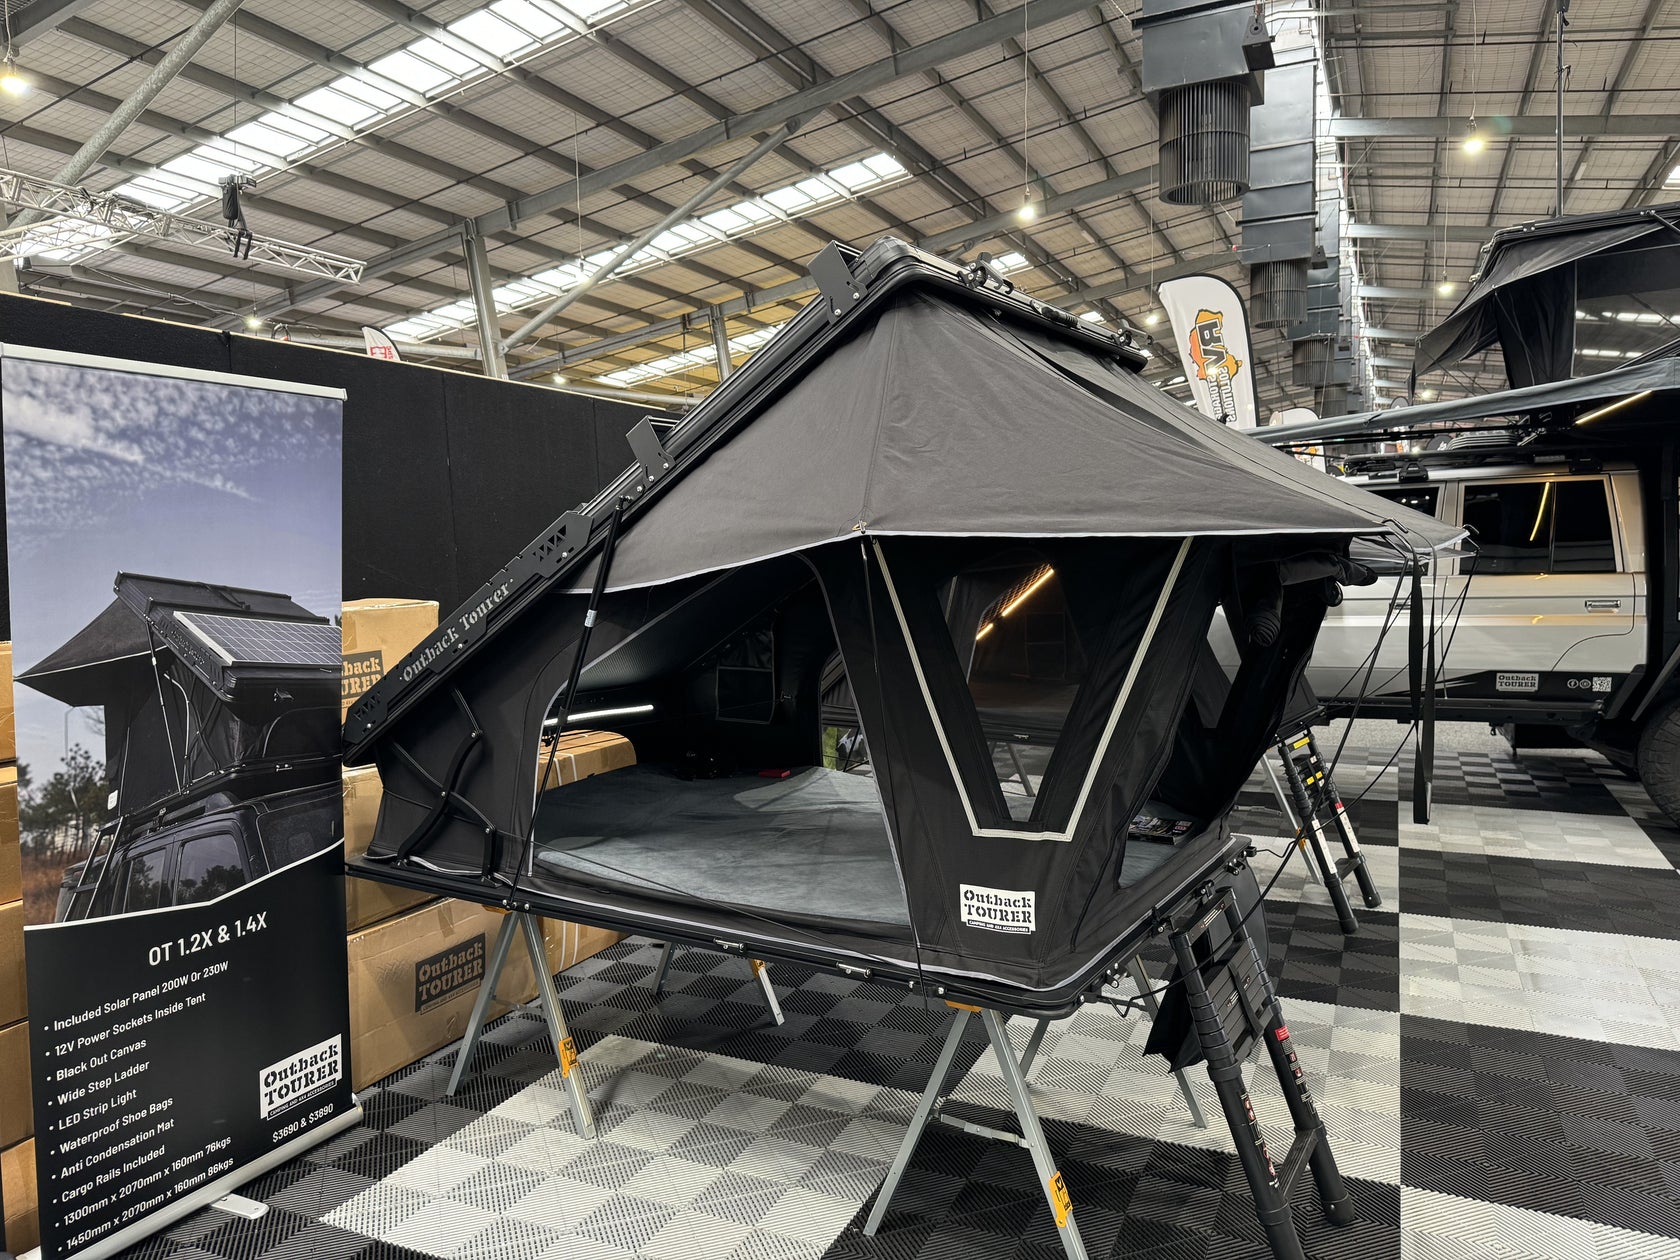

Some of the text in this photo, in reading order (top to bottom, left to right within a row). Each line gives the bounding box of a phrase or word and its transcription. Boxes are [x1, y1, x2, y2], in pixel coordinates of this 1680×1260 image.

[403, 583, 509, 682] Outback Tourer
[342, 657, 381, 677] back
[963, 889, 1032, 909] Outback
[963, 903, 1032, 924] TOURER
[149, 911, 268, 966] OT 1.2X & 1.4X
[418, 958, 483, 1001] TOURER
[419, 942, 483, 982] Outback
[54, 961, 229, 1031] Included Solar Panel 200W Or 230W
[55, 992, 206, 1056] 12V Power Sockets Inside Tent
[56, 1039, 147, 1081] Black Out Canvas
[57, 1061, 150, 1105] Wide Step Ladder
[264, 1043, 339, 1088] Outback
[264, 1059, 339, 1106] TOURER
[58, 1089, 137, 1130] LED Strip Light
[60, 1097, 173, 1154] Waterproof Shoe Bags
[272, 1103, 334, 1143] $3690 & $3890
[61, 1119, 175, 1180] Anti Condensation Mat
[61, 1145, 166, 1202] Cargo Rails Included
[63, 1136, 232, 1226] 1300mm x 2070mm x 160mm 76kgs
[66, 1157, 234, 1250] 1450mm x 2070mm x 160mm 86kgs
